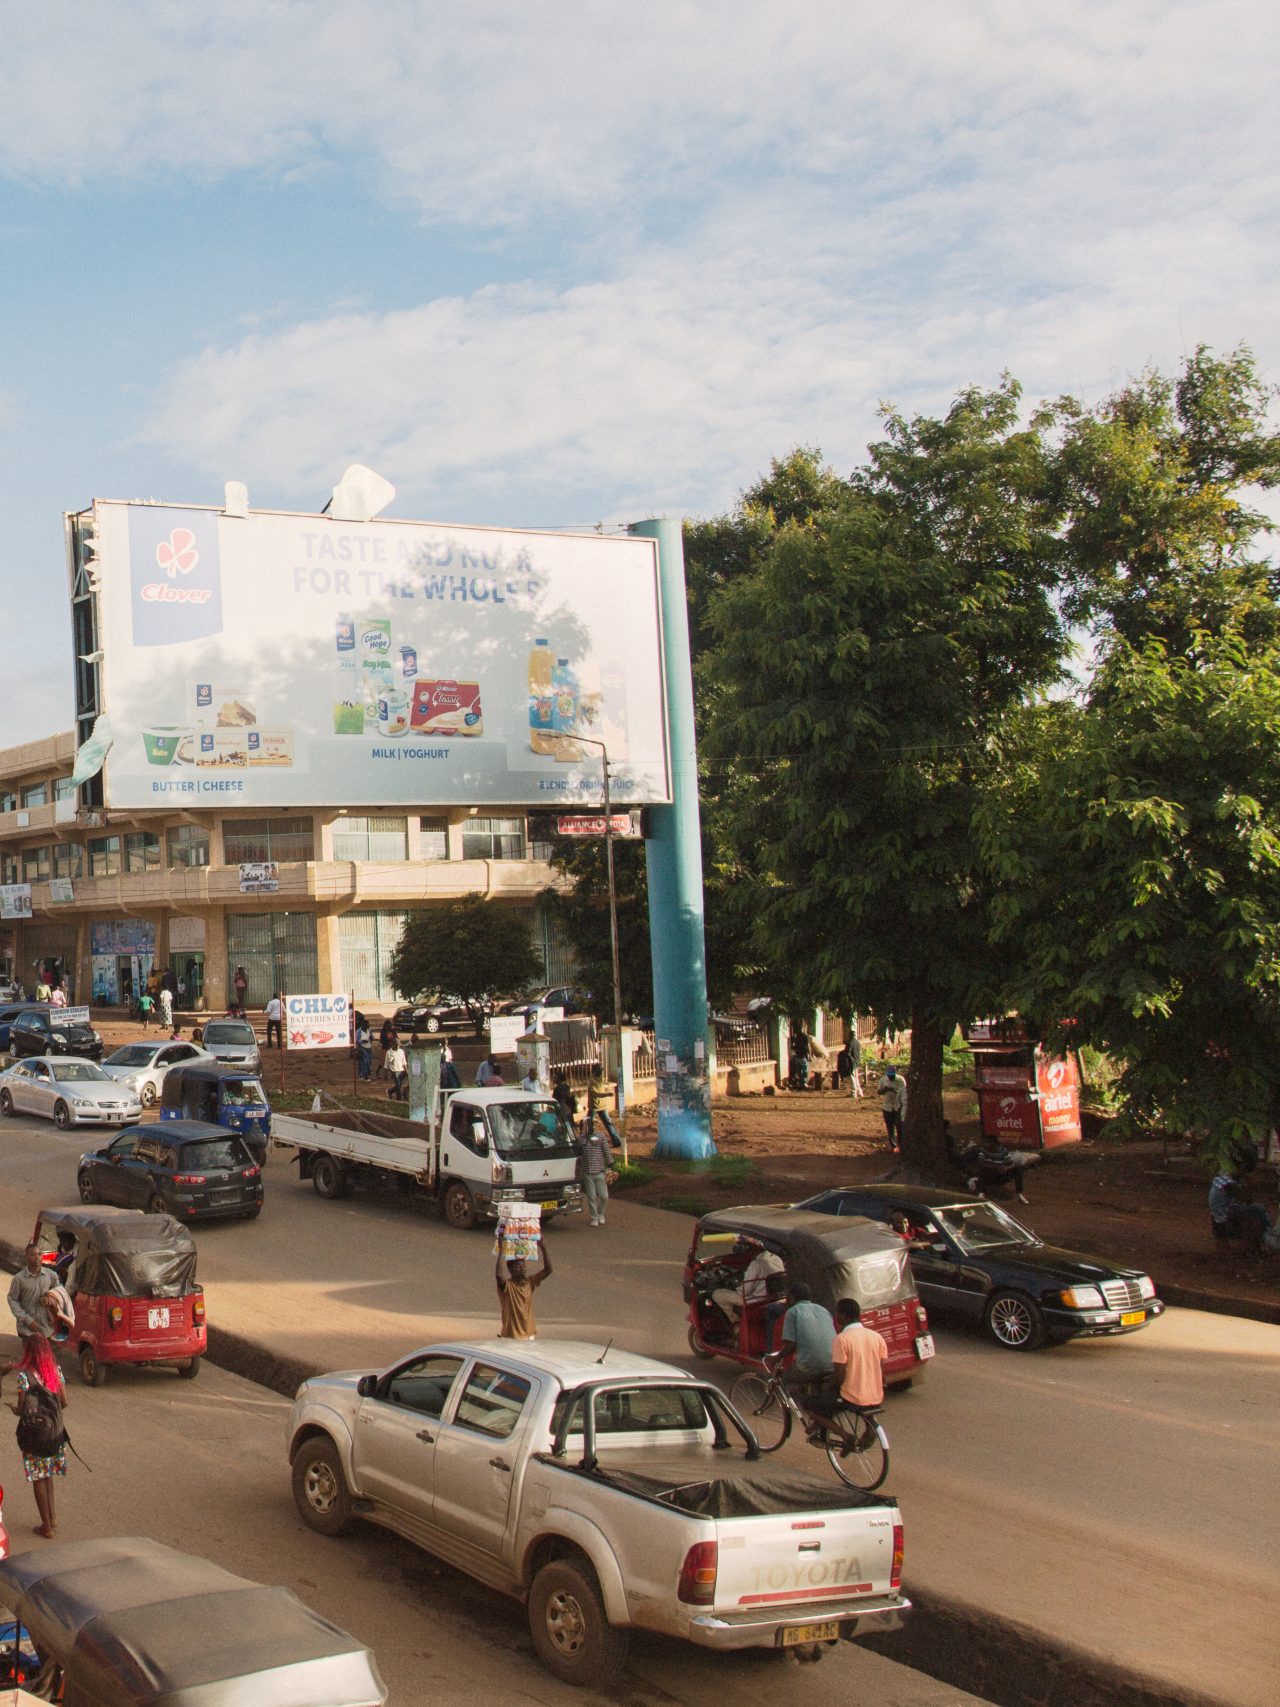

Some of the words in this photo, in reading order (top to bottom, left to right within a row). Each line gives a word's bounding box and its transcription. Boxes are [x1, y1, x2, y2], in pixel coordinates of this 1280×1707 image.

[300, 532, 386, 562] TASTE
[294, 567, 351, 596] FOR
[357, 570, 415, 599] THE
[422, 575, 519, 604] WHOLE
[141, 583, 212, 604] Clover
[364, 633, 382, 643] Good
[369, 641, 387, 649] Hope
[372, 749, 396, 759] MILK
[403, 749, 450, 759] YOGHURT
[152, 781, 195, 792] BUTTER
[202, 781, 244, 791] CHEESE
[562, 821, 595, 829] ALLIANCE
[290, 1015, 331, 1023] BATTERIES
[1044, 1091, 1073, 1113] airtel
[996, 1116, 1024, 1129] airtel
[750, 1556, 863, 1590] TOYOTA
